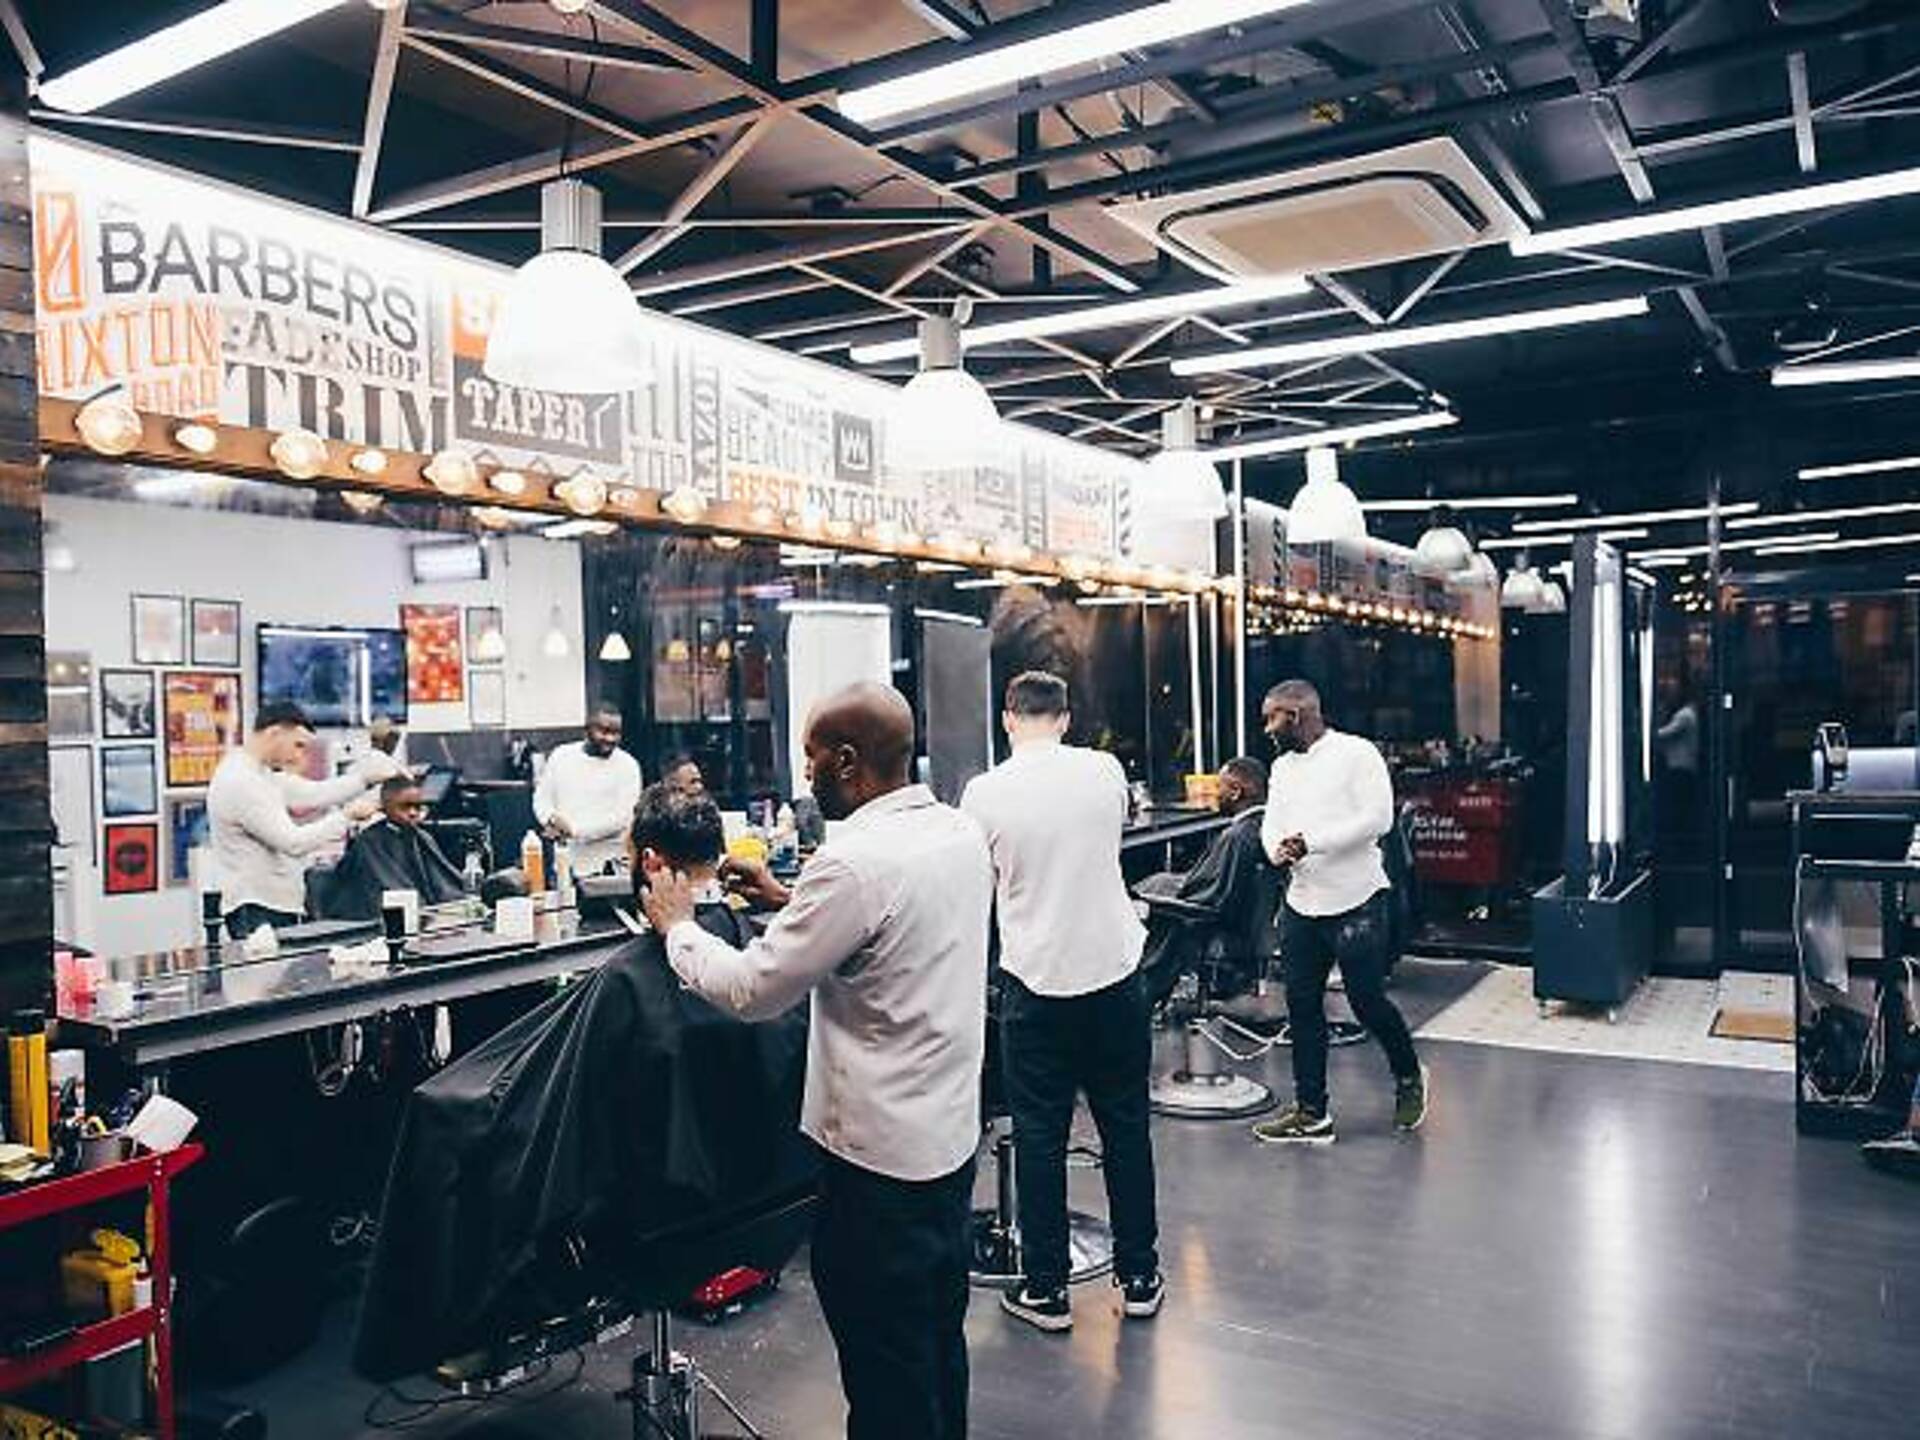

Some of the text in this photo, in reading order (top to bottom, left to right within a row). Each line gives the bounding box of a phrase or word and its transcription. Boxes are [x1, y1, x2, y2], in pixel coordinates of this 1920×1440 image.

[97, 220, 418, 350] BARBERS
[345, 338, 421, 383] SHOP
[223, 360, 450, 452] TRIM
[462, 375, 588, 449] TAPER
[728, 470, 801, 514] BEST
